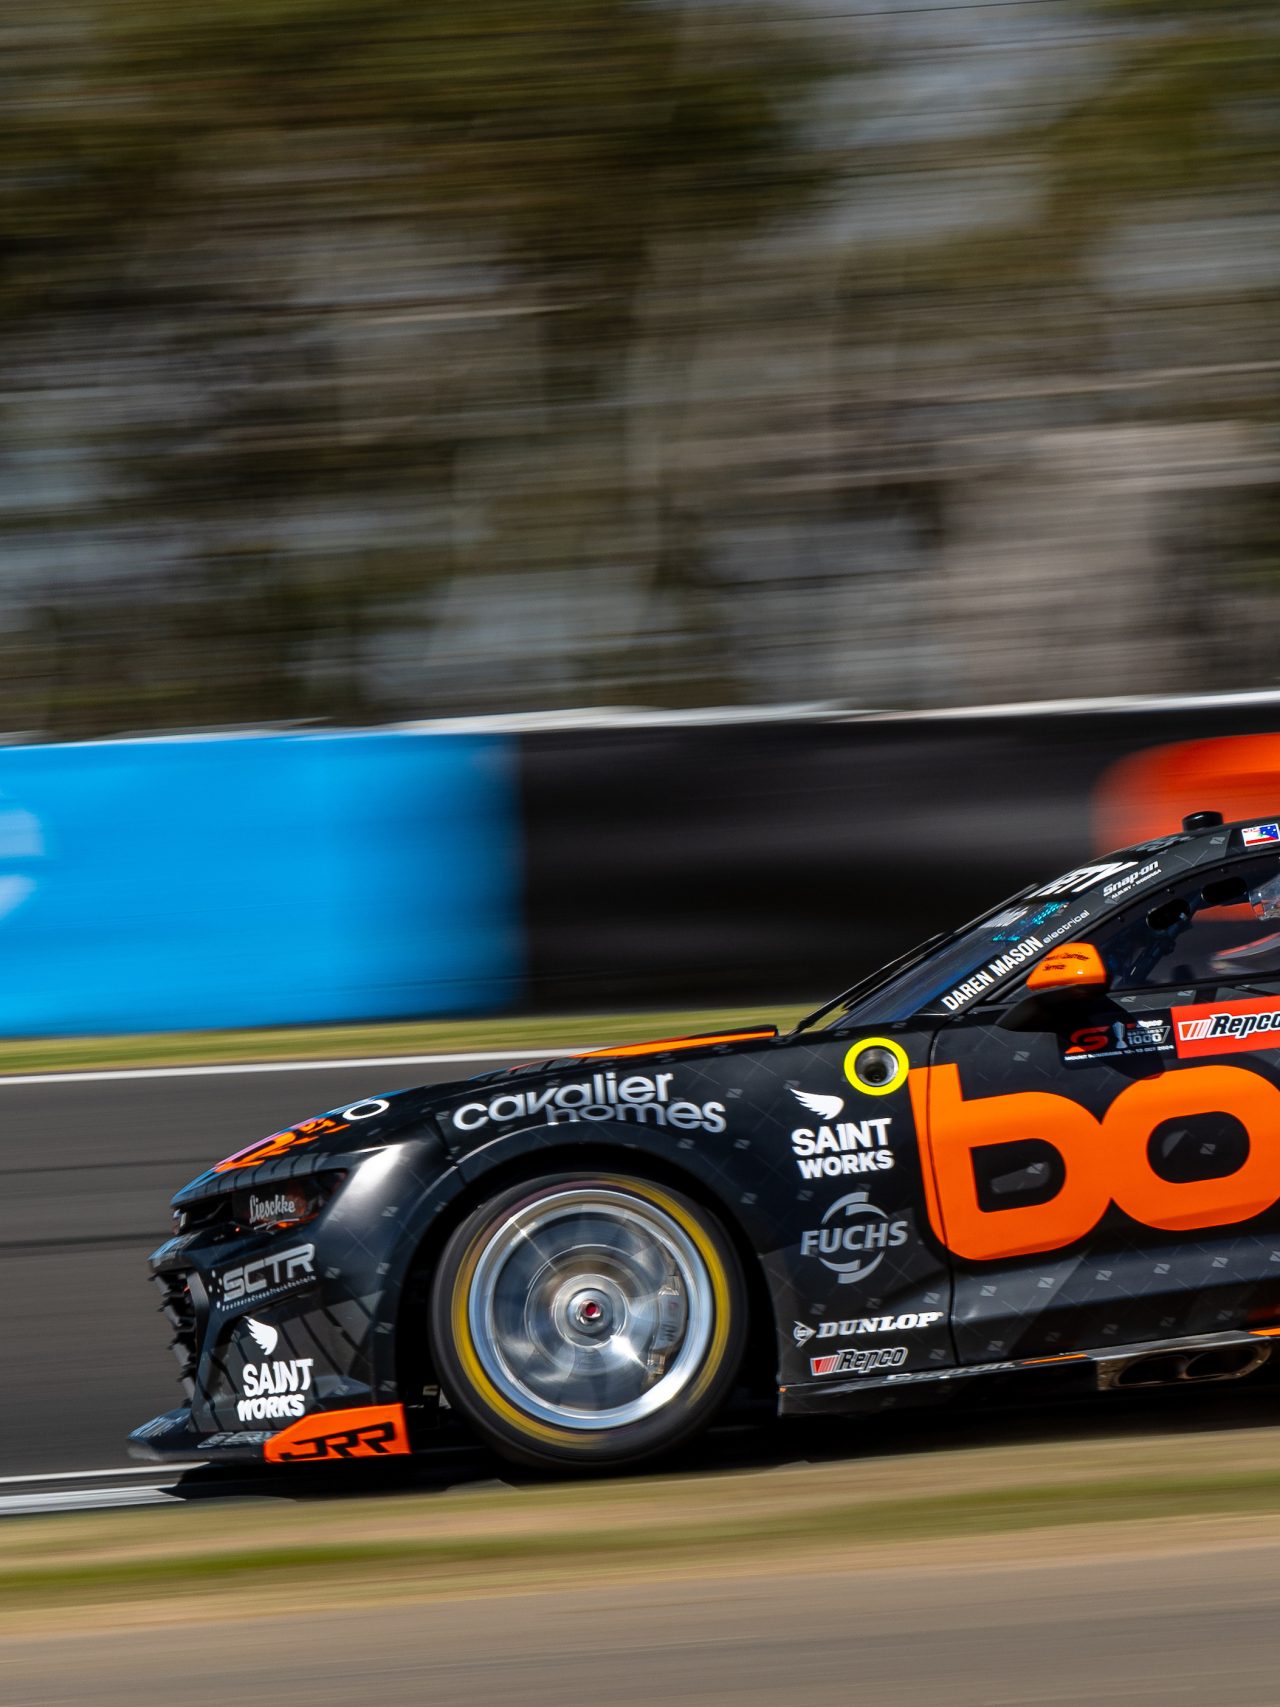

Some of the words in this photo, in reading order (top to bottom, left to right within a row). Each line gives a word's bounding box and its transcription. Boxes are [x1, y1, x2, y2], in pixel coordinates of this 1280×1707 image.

[1103, 861, 1158, 897] Snap-on
[941, 971, 995, 1010] DAREN
[989, 935, 1044, 977] MASON
[1043, 910, 1090, 944] electrical
[1128, 1033, 1162, 1044] 1000
[453, 1072, 673, 1130] cavalier
[791, 1118, 892, 1157] SAINT
[797, 1149, 894, 1179] WORKS
[249, 1194, 296, 1224] Lieschke
[802, 1221, 907, 1255] FUCHS
[223, 1243, 315, 1302] SCTR
[816, 1311, 944, 1338] DUNLOP
[835, 1347, 908, 1374] Repco
[243, 1359, 313, 1397] SAINT
[237, 1394, 305, 1422] WORKS
